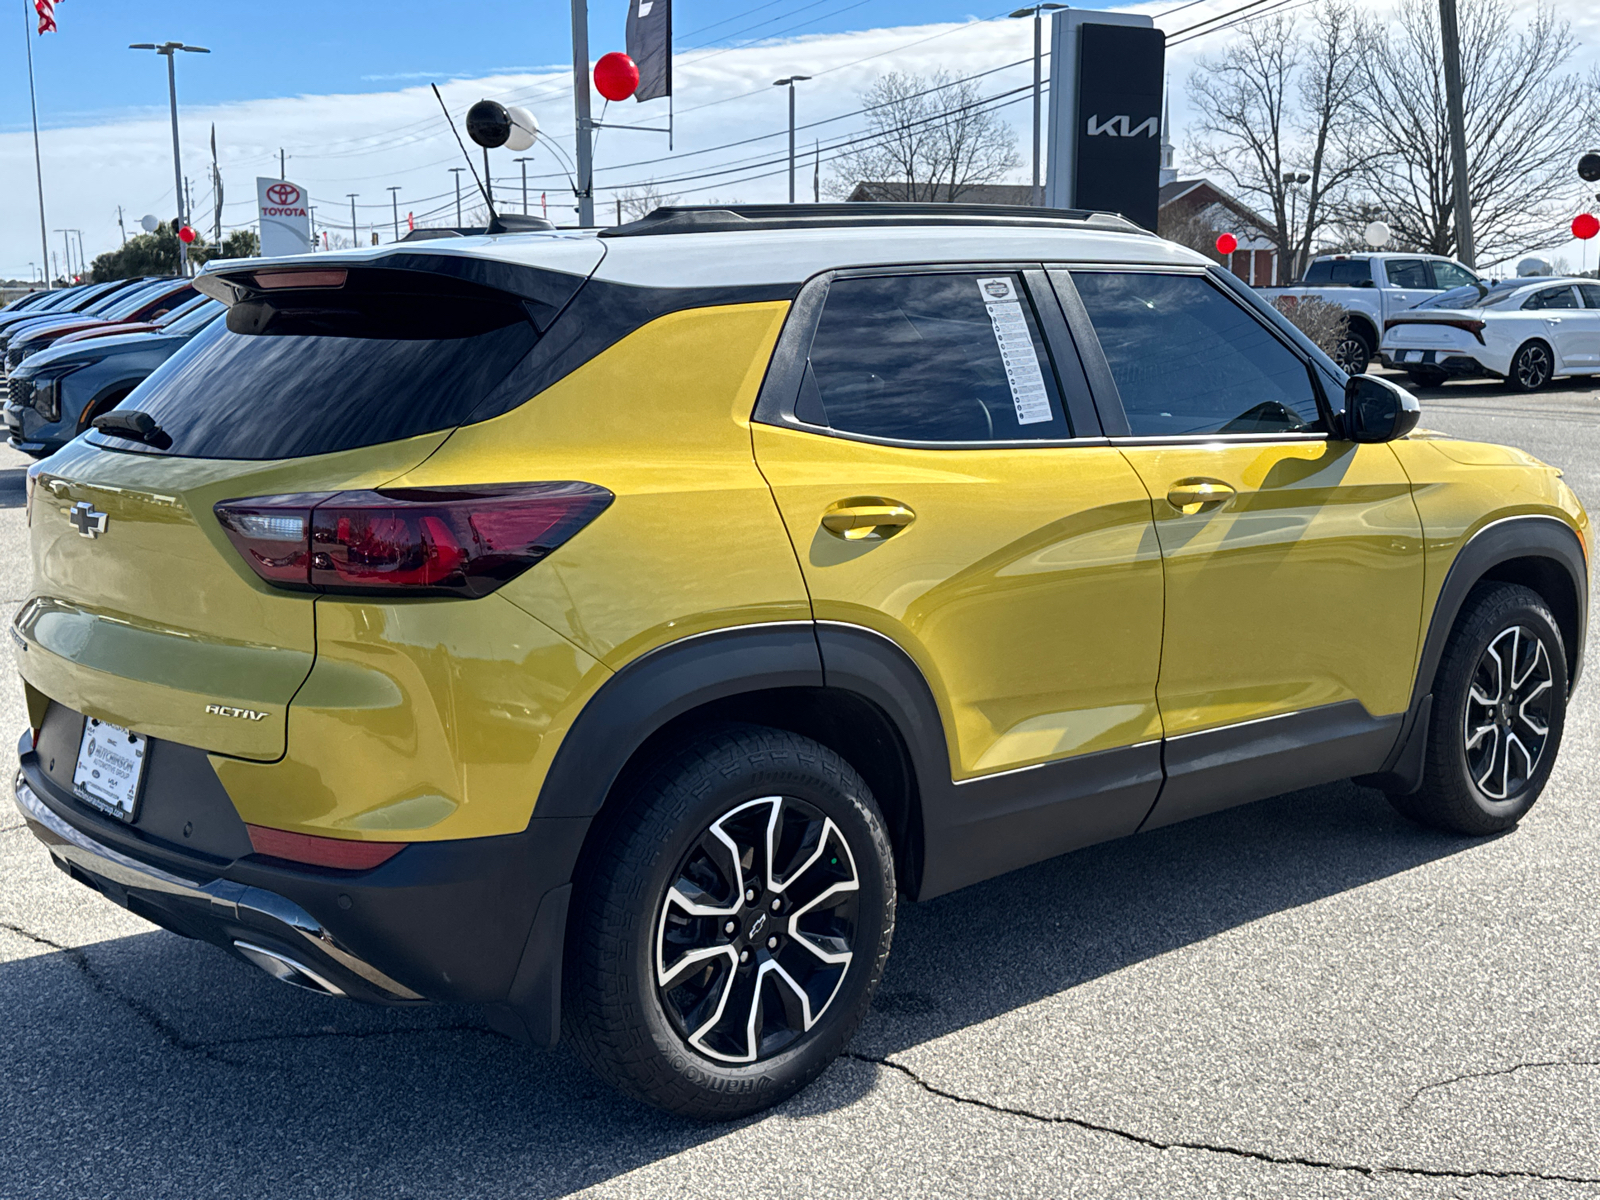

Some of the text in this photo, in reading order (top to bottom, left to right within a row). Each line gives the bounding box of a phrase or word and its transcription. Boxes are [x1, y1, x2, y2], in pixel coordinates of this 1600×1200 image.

[1087, 114, 1158, 138] KIA
[262, 207, 307, 217] TOYOTA
[205, 704, 271, 721] ACTIV
